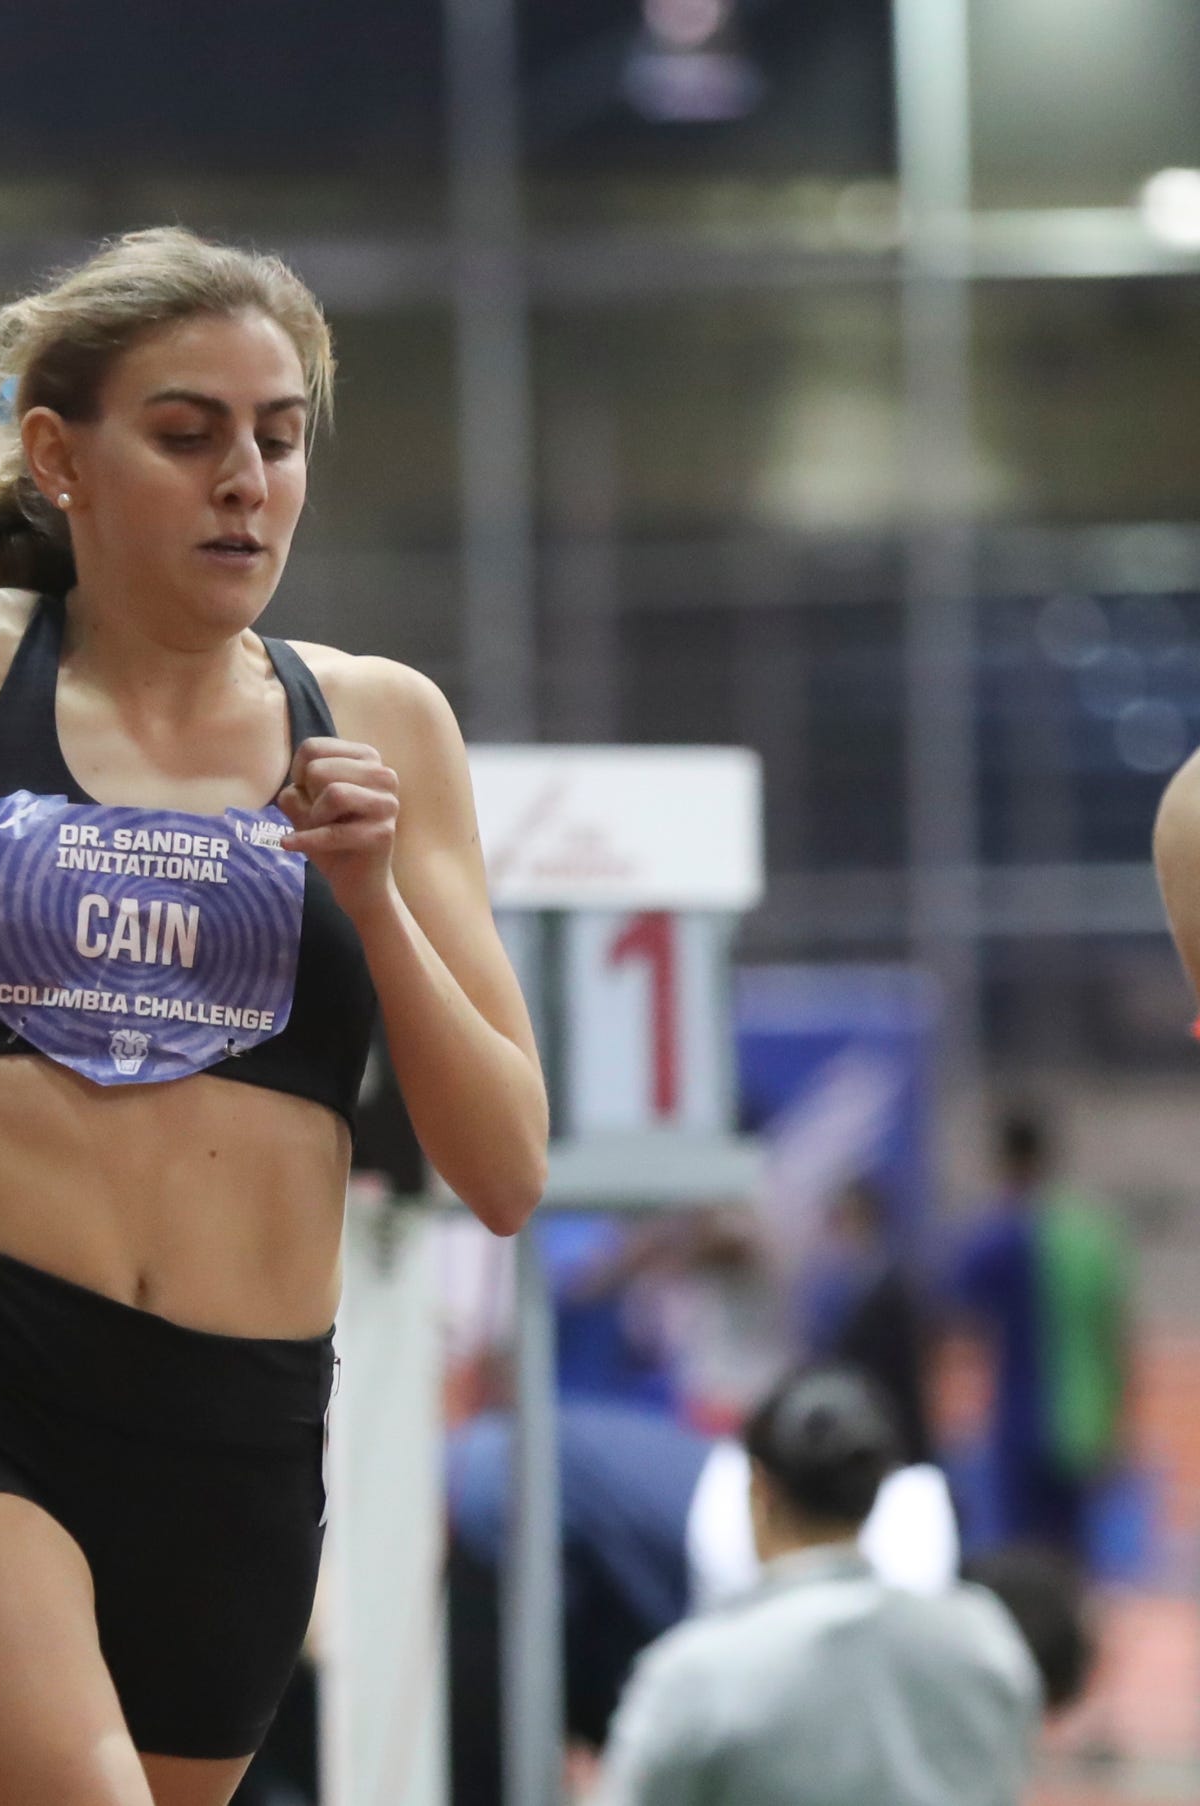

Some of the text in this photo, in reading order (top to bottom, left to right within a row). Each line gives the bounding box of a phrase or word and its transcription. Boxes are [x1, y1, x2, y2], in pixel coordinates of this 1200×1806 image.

[59, 824, 230, 859] DR. SANDER
[258, 836, 281, 848] SER
[56, 848, 228, 883] INVITATIONAL
[76, 893, 200, 969] CAIN
[134, 995, 275, 1031] CHALLENGE
[608, 909, 678, 1126] 1
